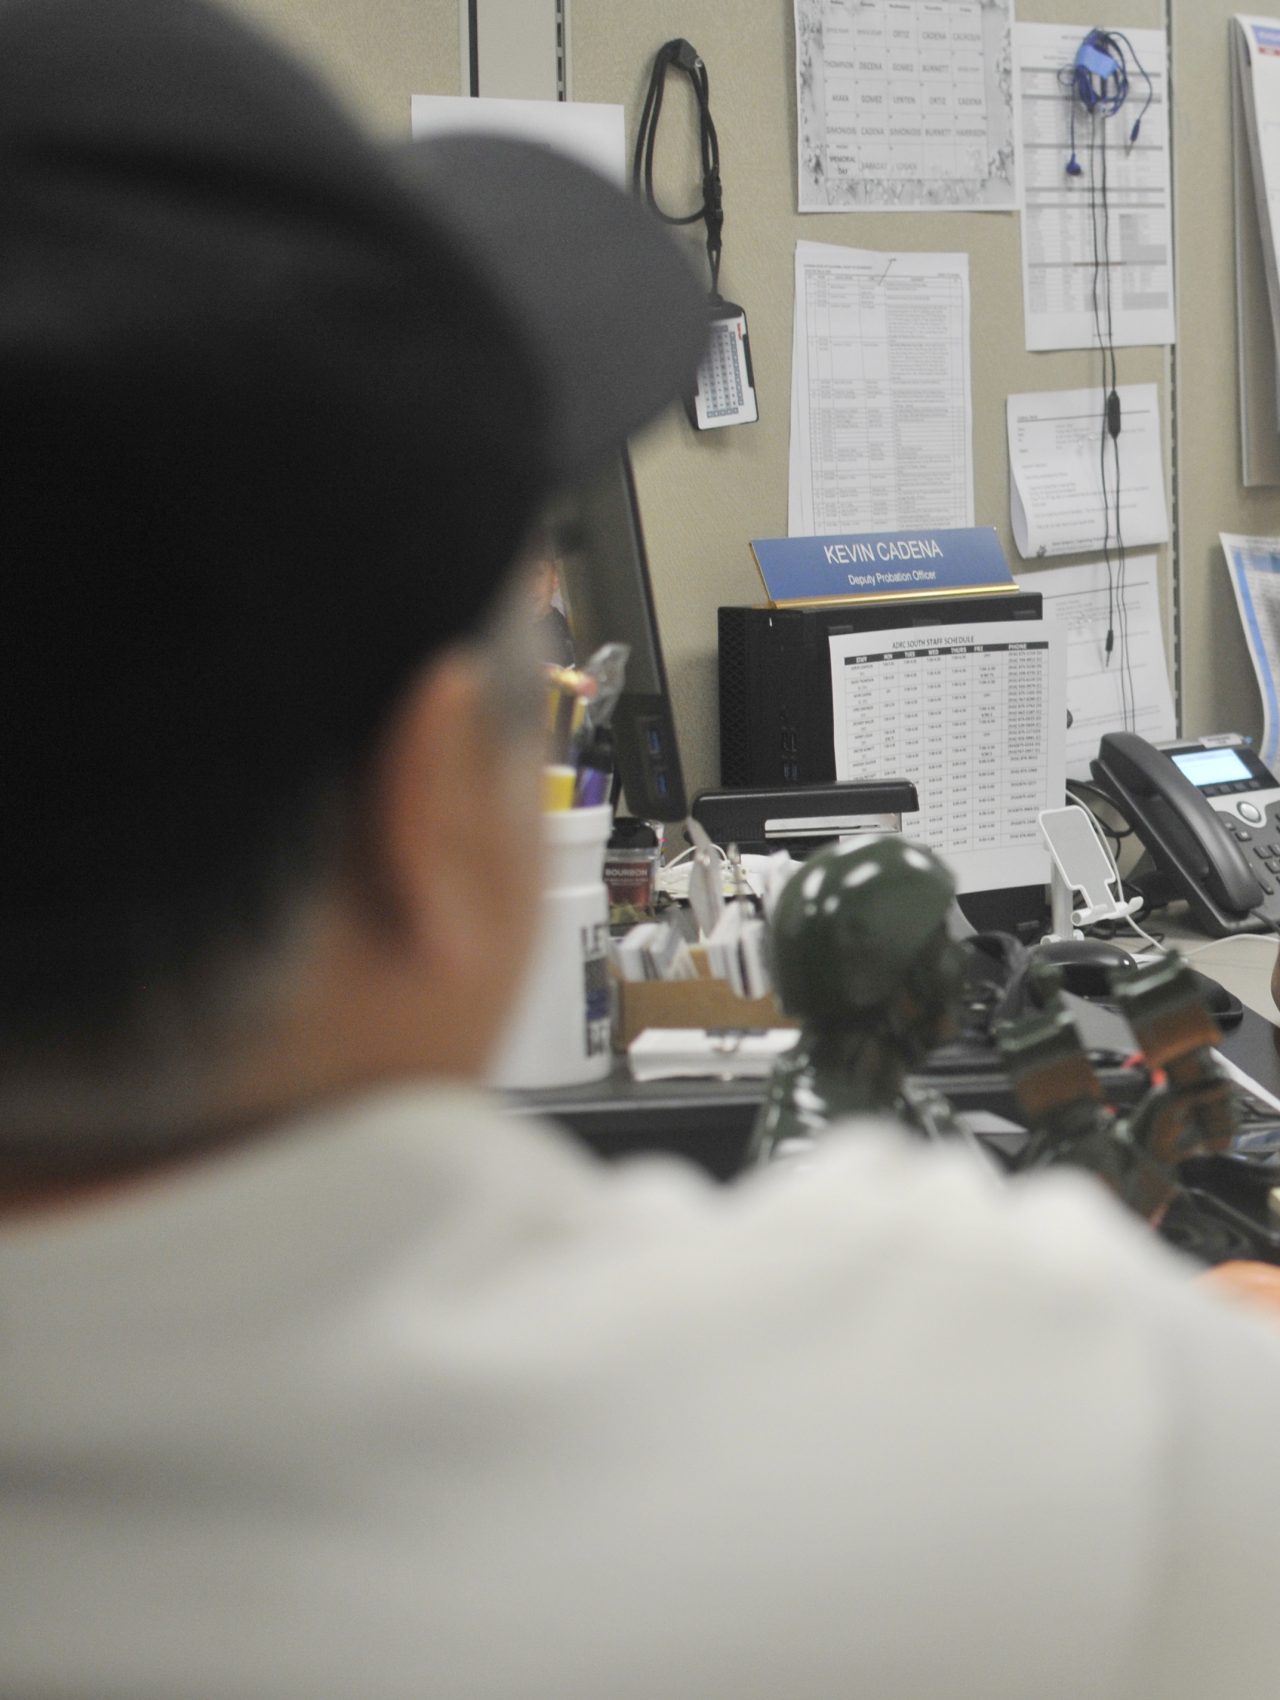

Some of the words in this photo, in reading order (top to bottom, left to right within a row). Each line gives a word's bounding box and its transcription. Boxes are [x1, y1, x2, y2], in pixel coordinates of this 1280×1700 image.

[823, 543, 875, 565] KEVIN
[876, 538, 944, 561] CADENA
[848, 573, 876, 587] Deputy
[876, 570, 912, 584] Probation
[912, 569, 937, 582] Officer
[907, 639, 926, 649] SOUTH
[926, 637, 943, 647] STAFF
[944, 635, 975, 645] SCHEDULE
[605, 868, 648, 876] BOURBON
